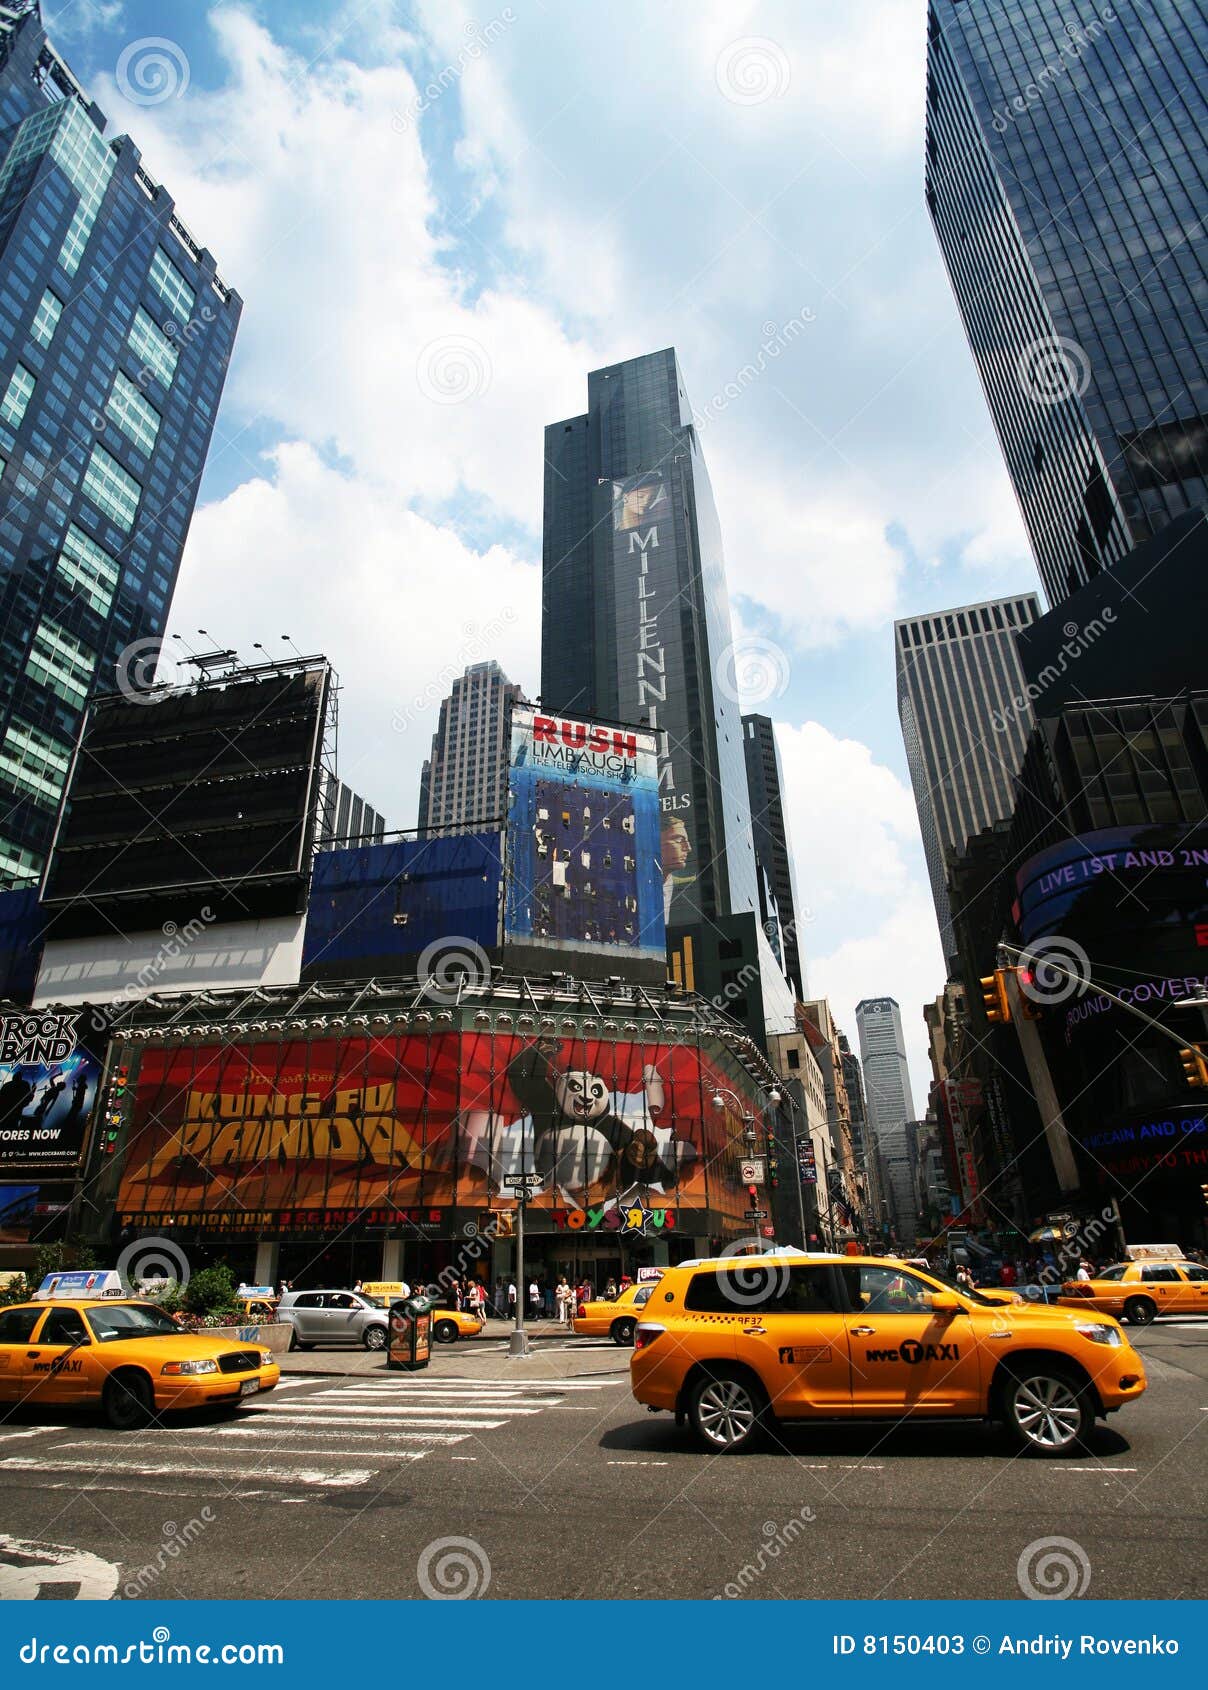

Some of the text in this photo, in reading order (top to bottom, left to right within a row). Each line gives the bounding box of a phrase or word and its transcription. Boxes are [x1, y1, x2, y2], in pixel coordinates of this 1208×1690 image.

[533, 716, 637, 758] RUSH
[533, 741, 637, 774] LIMBAUGH
[533, 756, 638, 782] THE TELEVISION SHOW
[1039, 865, 1076, 894] LIVE
[1083, 854, 1117, 876] 1ST
[1125, 851, 1175, 869] AND
[1117, 976, 1208, 1005] COVER
[2, 1013, 84, 1043] ROCK
[0, 1037, 76, 1070] BAND
[185, 1082, 396, 1119] KUNG FU
[32, 1128, 61, 1140] NOW
[1140, 1121, 1176, 1141] AND
[129, 1116, 449, 1184] PANDA
[527, 1176, 540, 1184] WAY
[279, 1211, 359, 1225] BEGINS
[367, 1209, 422, 1223] JUNE
[428, 1209, 442, 1222] 6
[551, 1208, 622, 1230] TOYS
[653, 1207, 676, 1229] US
[738, 1317, 763, 1325] 9F37
[866, 1339, 960, 1364] NYC TAXI
